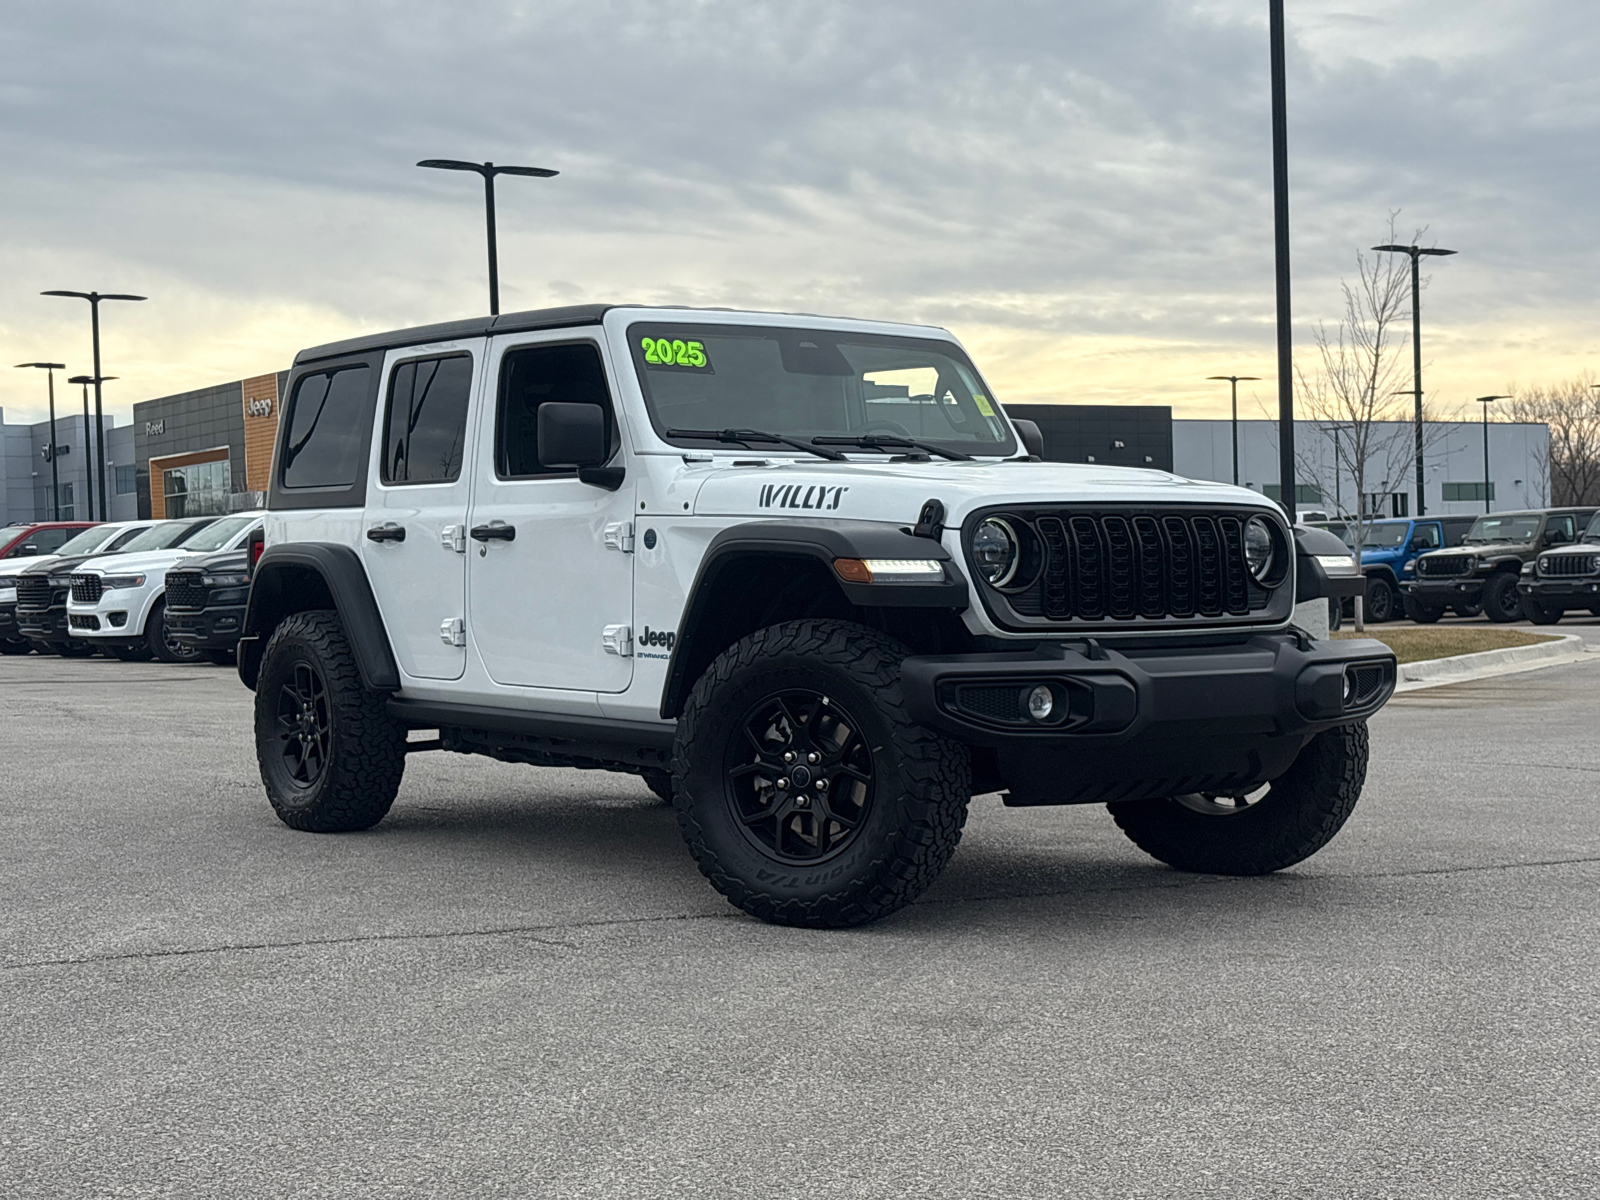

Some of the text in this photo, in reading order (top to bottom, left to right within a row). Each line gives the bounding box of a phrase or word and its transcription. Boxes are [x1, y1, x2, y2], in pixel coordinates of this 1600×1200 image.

[641, 337, 707, 367] 2025
[248, 397, 271, 418] Jeep
[146, 419, 165, 436] Reed
[759, 484, 850, 510] WILLYS
[639, 625, 676, 651] Jeep
[643, 652, 672, 660] WRANGL
